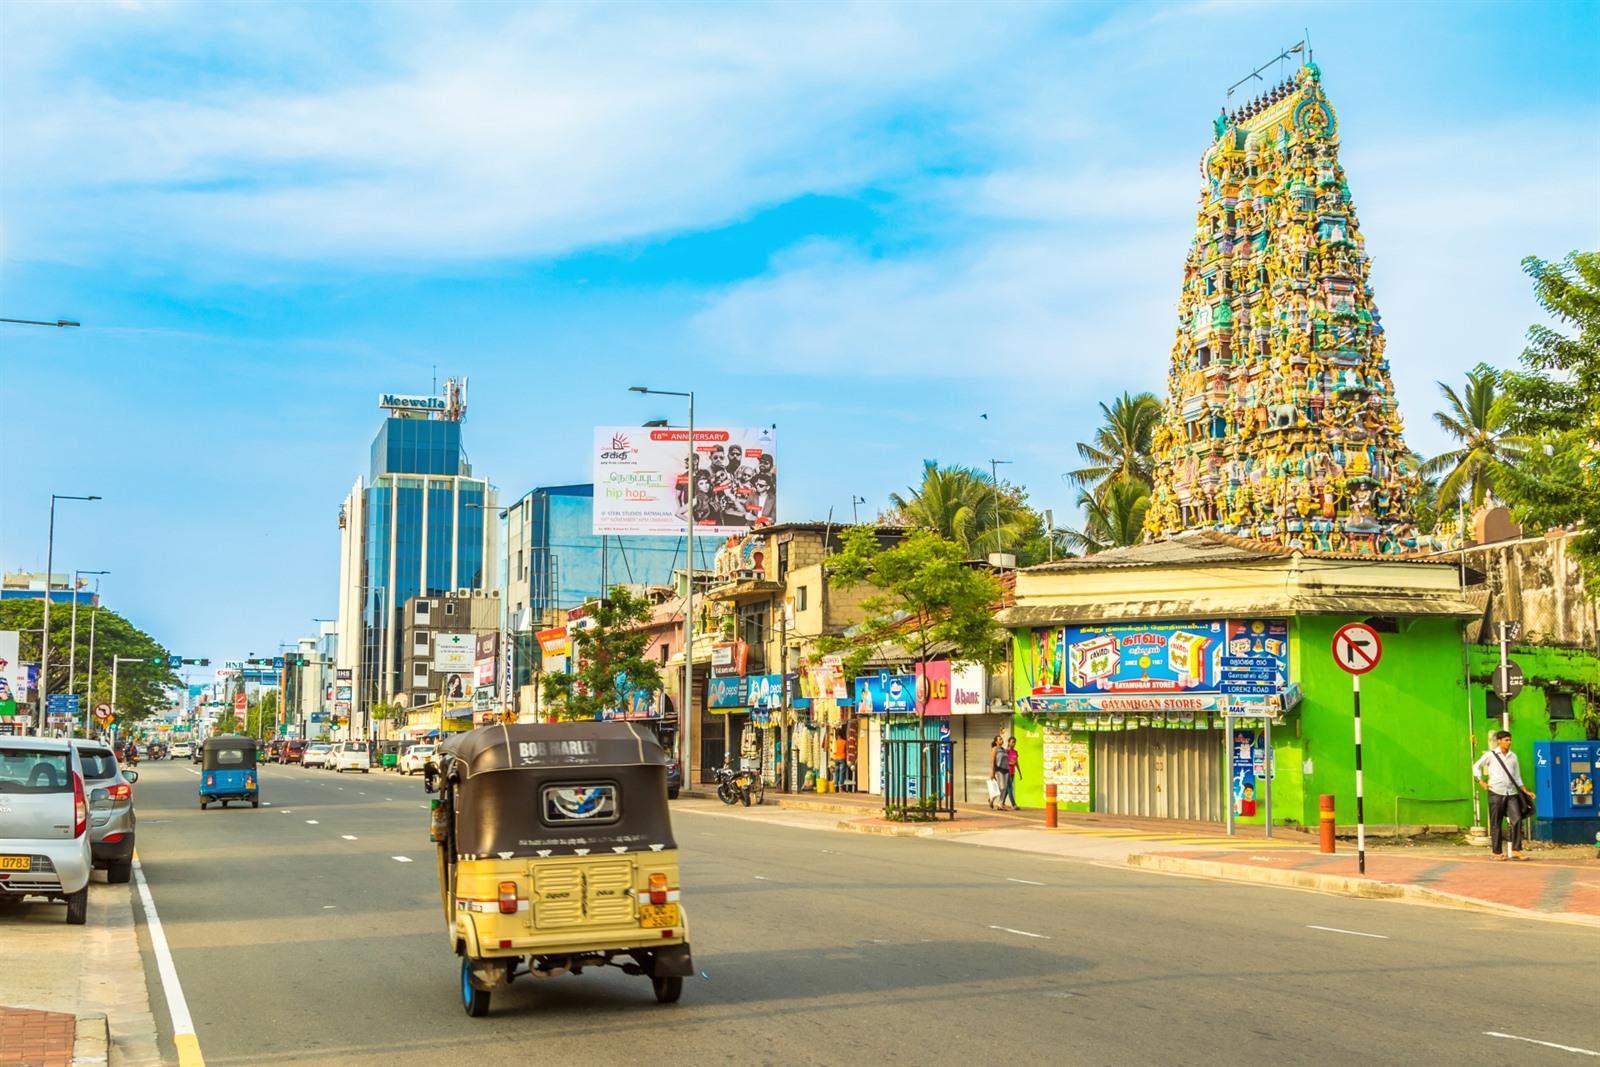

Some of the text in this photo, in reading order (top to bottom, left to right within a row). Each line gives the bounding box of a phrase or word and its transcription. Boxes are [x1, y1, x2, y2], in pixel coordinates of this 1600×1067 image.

[382, 394, 445, 408] Meewella
[606, 487, 647, 499] hip hop
[1122, 633, 1167, 647] காவடி
[225, 661, 244, 669] HNB
[881, 672, 888, 689] P
[930, 678, 948, 699] LG
[954, 688, 980, 704] Abans
[1164, 699, 1203, 709] STORES
[519, 740, 598, 757] BOB MARLEY
[2, 858, 30, 868] 0783
